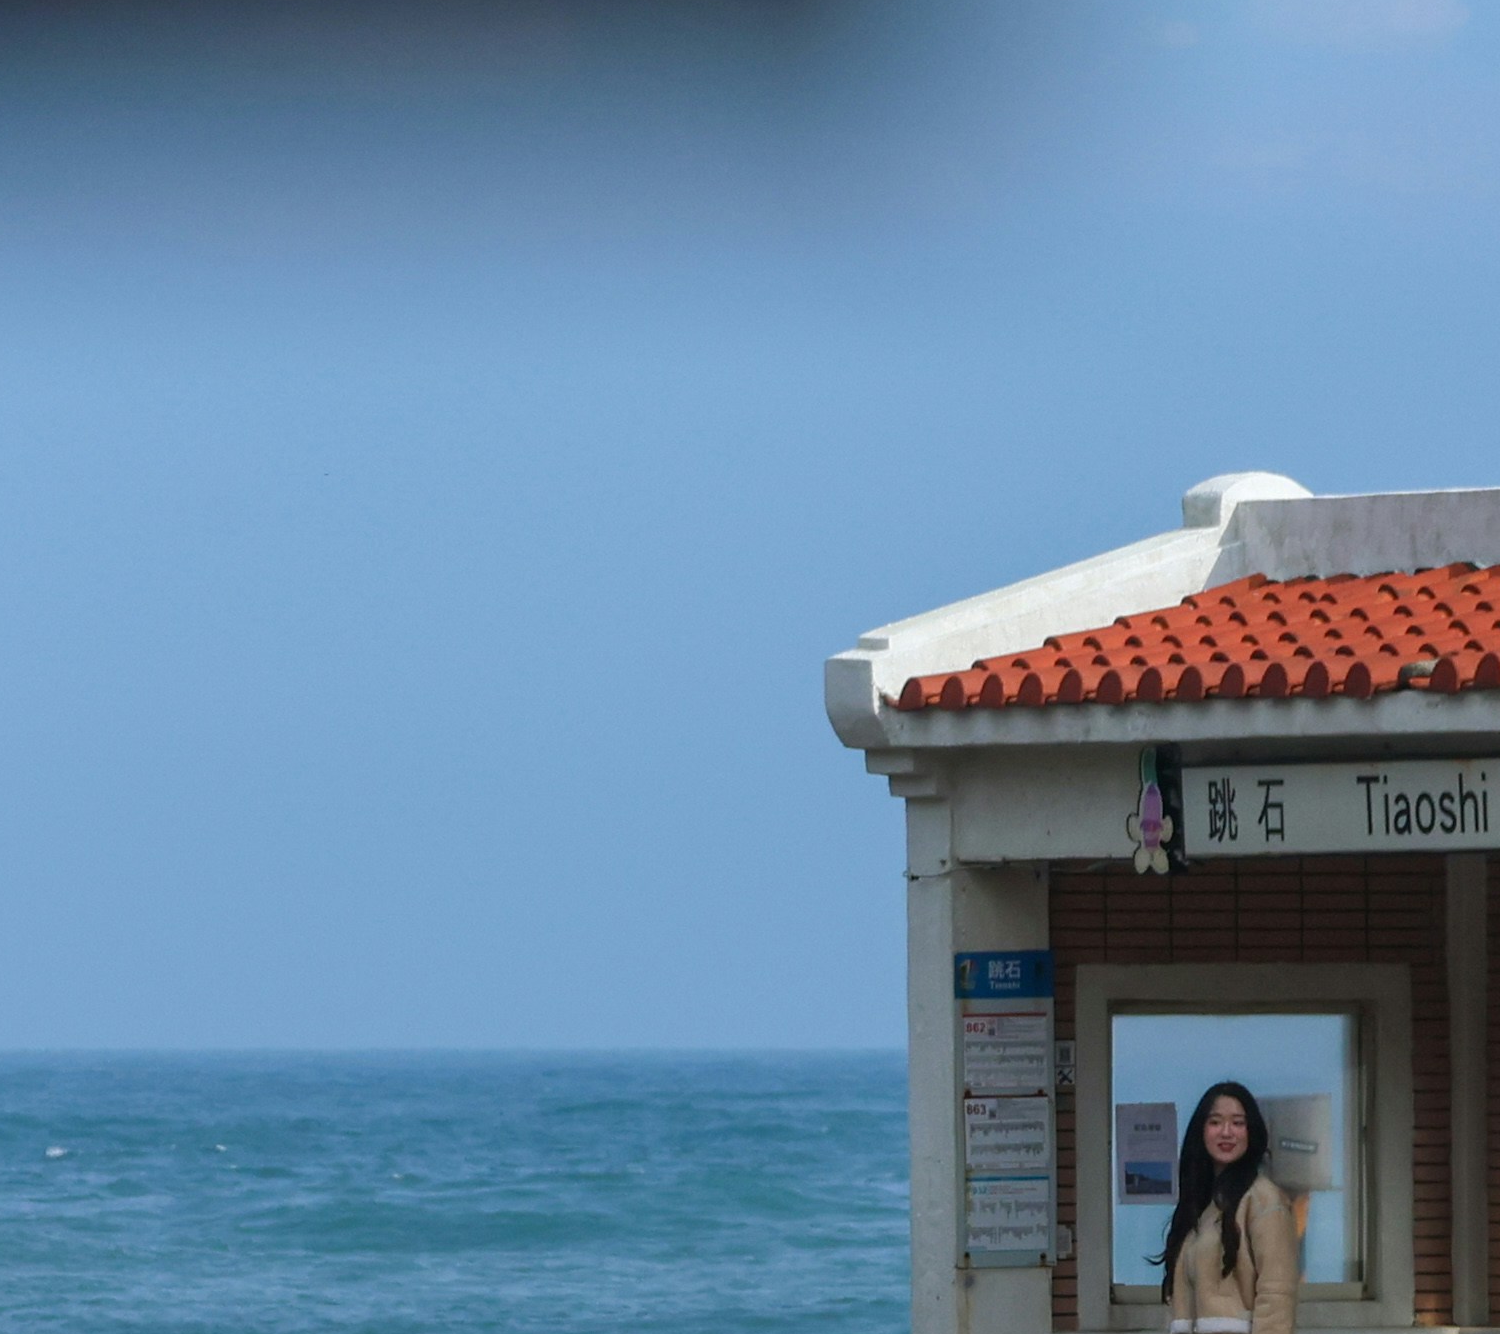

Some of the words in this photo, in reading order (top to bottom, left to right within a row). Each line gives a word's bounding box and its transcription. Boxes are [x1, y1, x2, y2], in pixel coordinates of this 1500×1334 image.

[1207, 777, 1285, 843] 跳石
[1356, 771, 1490, 836] Tiaoshi
[966, 1104, 987, 1115] 863
